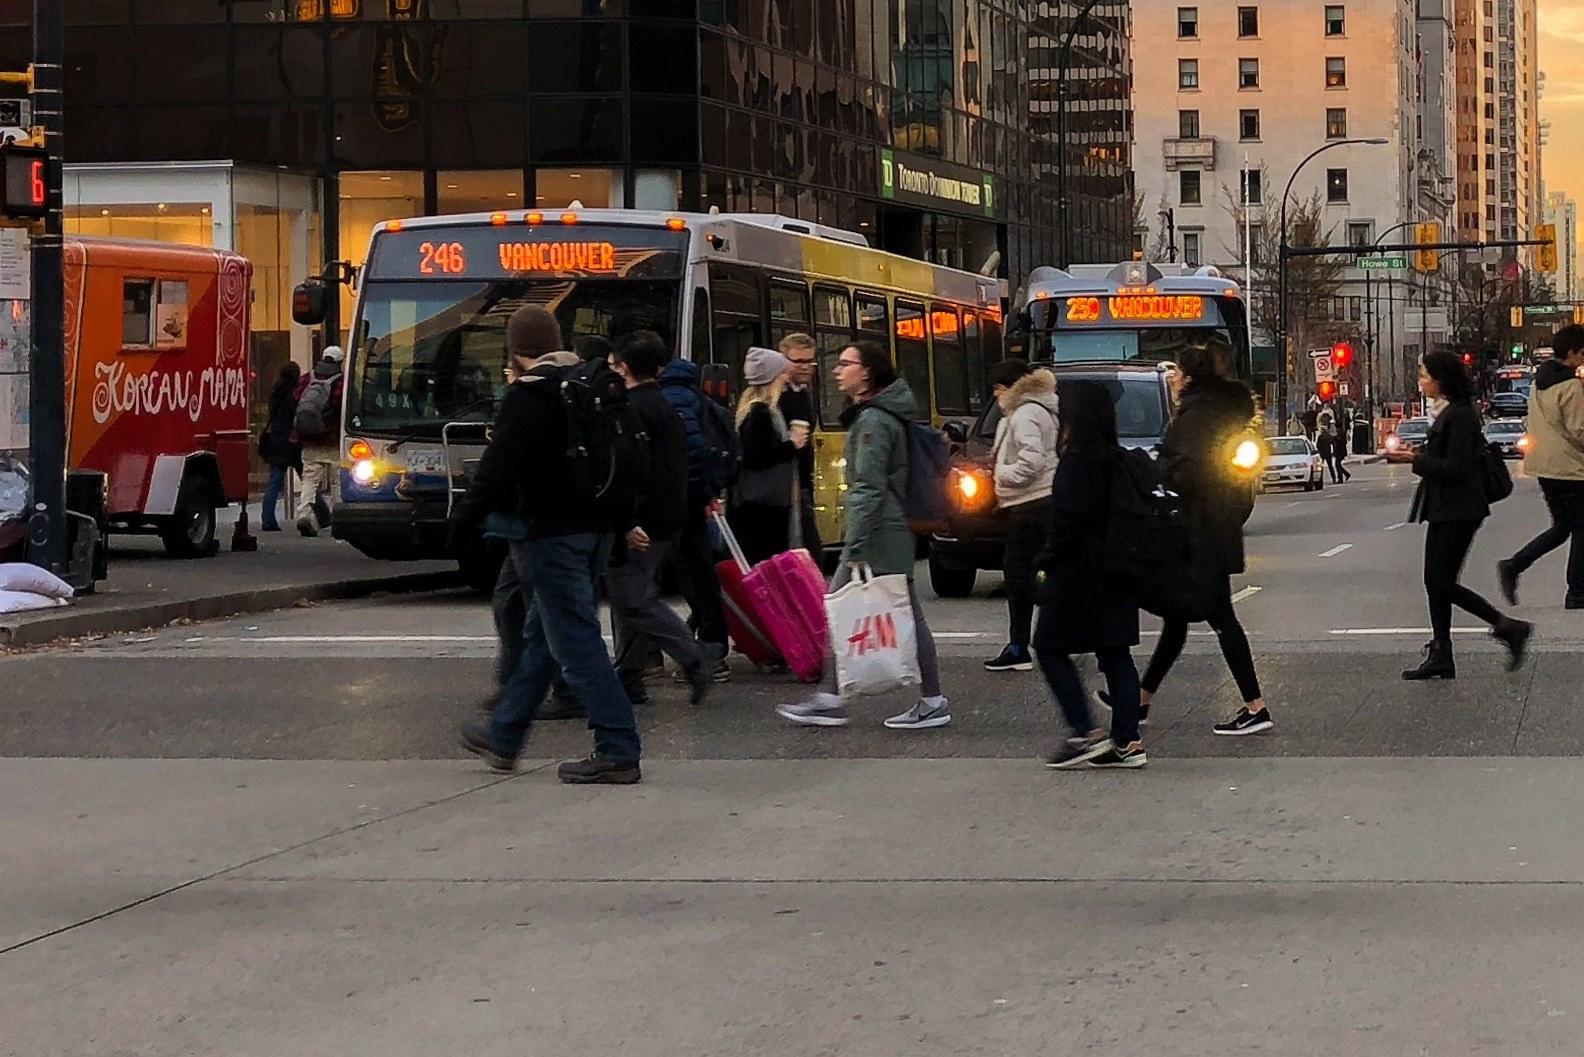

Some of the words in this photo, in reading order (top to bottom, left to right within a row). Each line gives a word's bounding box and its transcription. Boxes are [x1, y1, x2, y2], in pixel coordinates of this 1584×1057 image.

[31, 161, 44, 203] 6
[897, 162, 928, 195] TORONTO
[418, 242, 465, 273] 246
[499, 241, 615, 271] VANCOUVER
[1361, 259, 1388, 268] Howe
[1392, 259, 1403, 268] St
[1066, 297, 1100, 321] 250
[1108, 296, 1203, 320] VANCOUVER
[92, 360, 193, 424] KOREAN
[188, 366, 246, 422] MAMA
